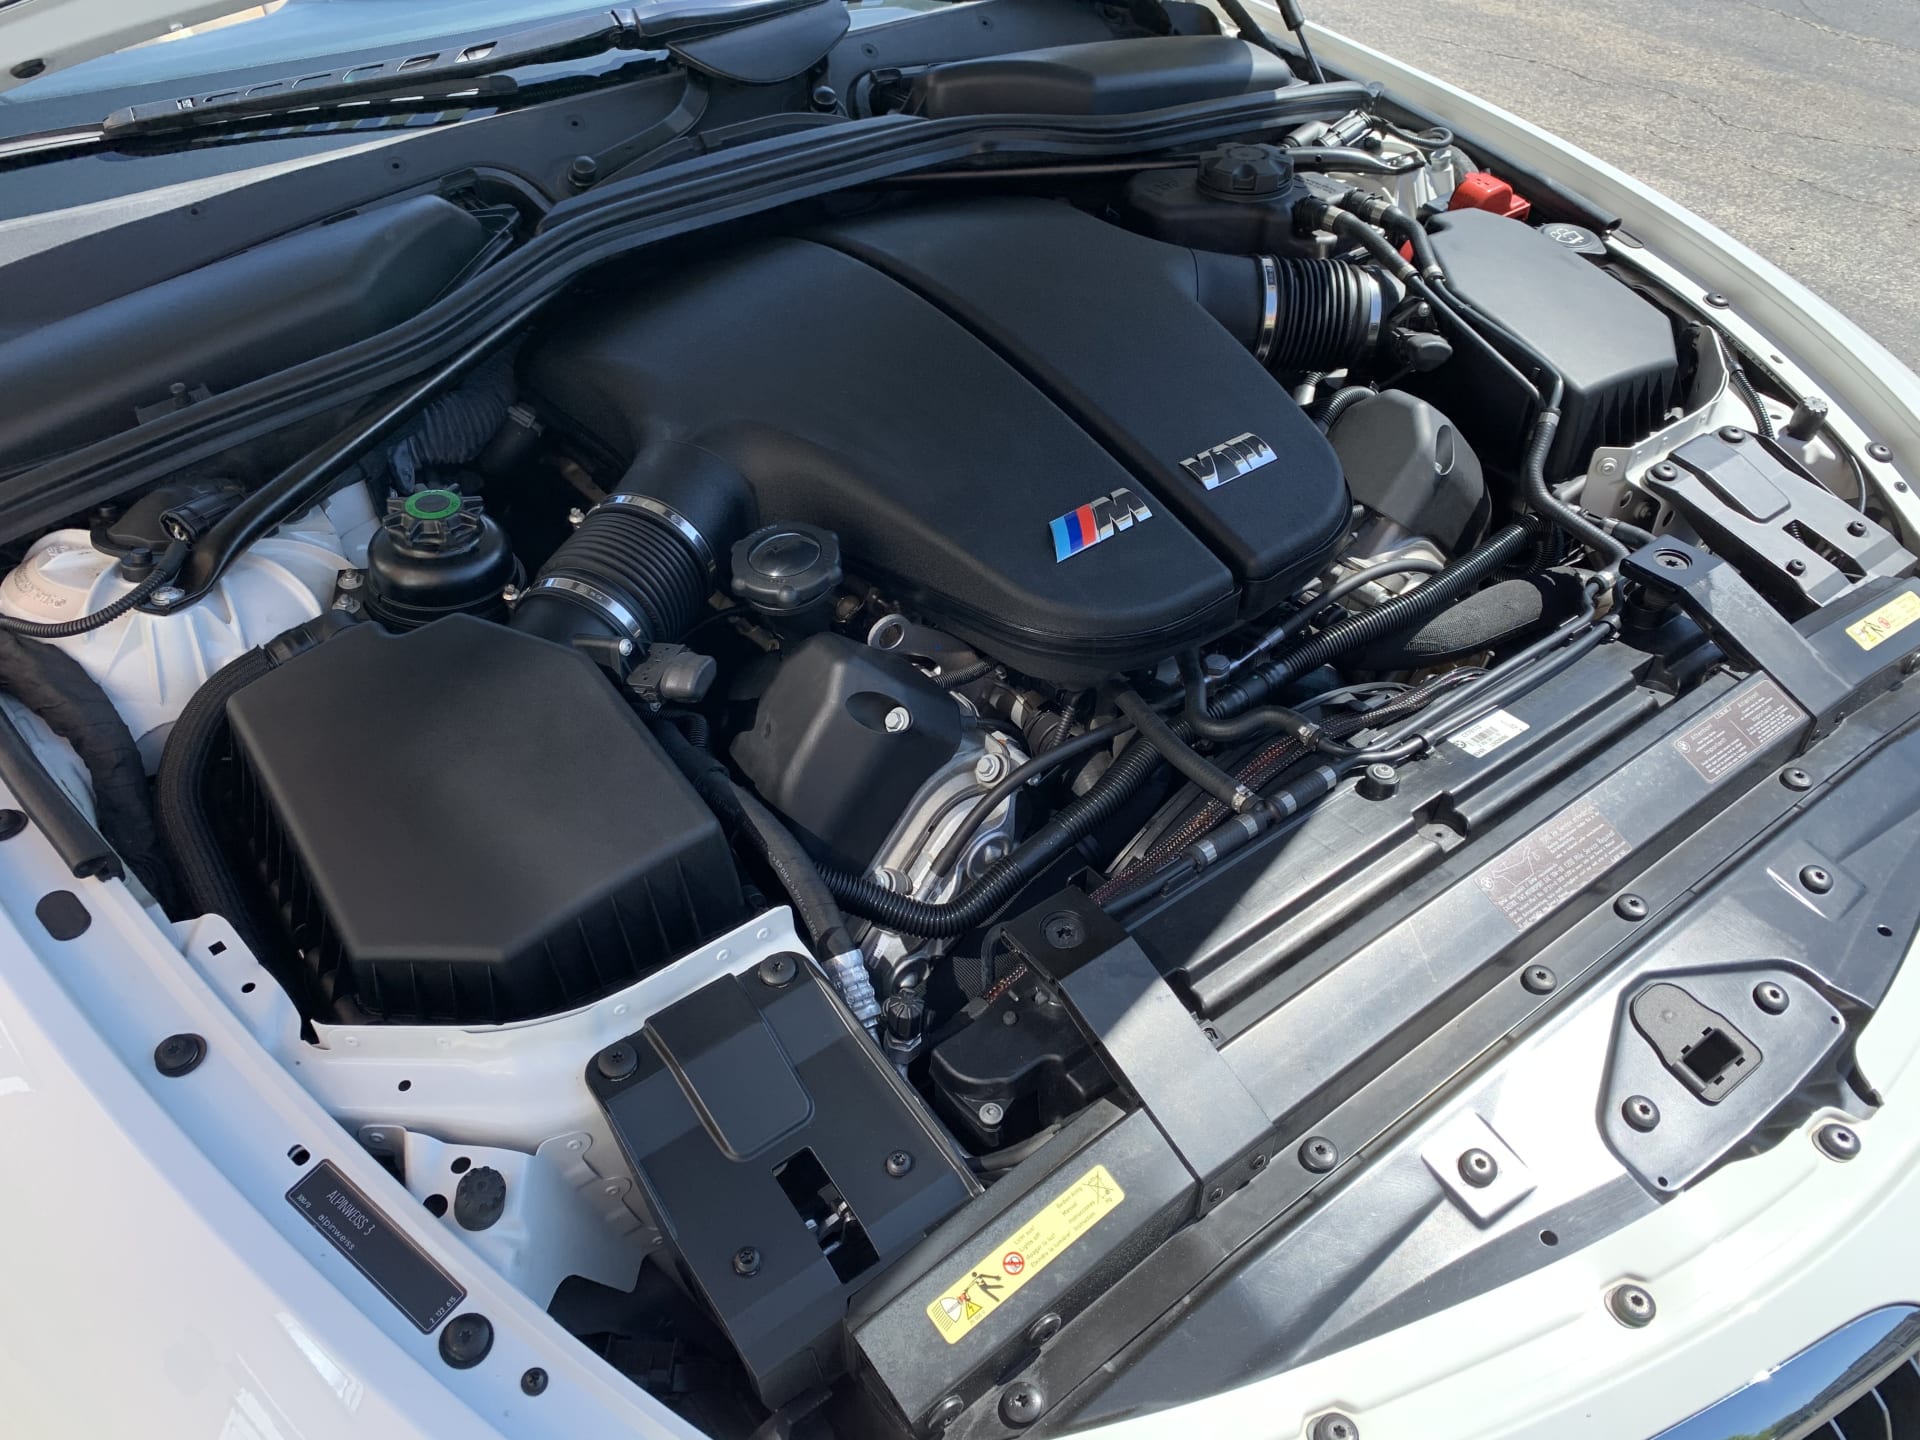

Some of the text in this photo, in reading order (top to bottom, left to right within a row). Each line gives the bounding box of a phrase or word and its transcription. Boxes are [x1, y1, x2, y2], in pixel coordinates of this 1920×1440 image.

[1091, 487, 1153, 543] M
[318, 1213, 355, 1251] alpinweiss
[326, 1189, 376, 1236] ALPINWEISS 3
